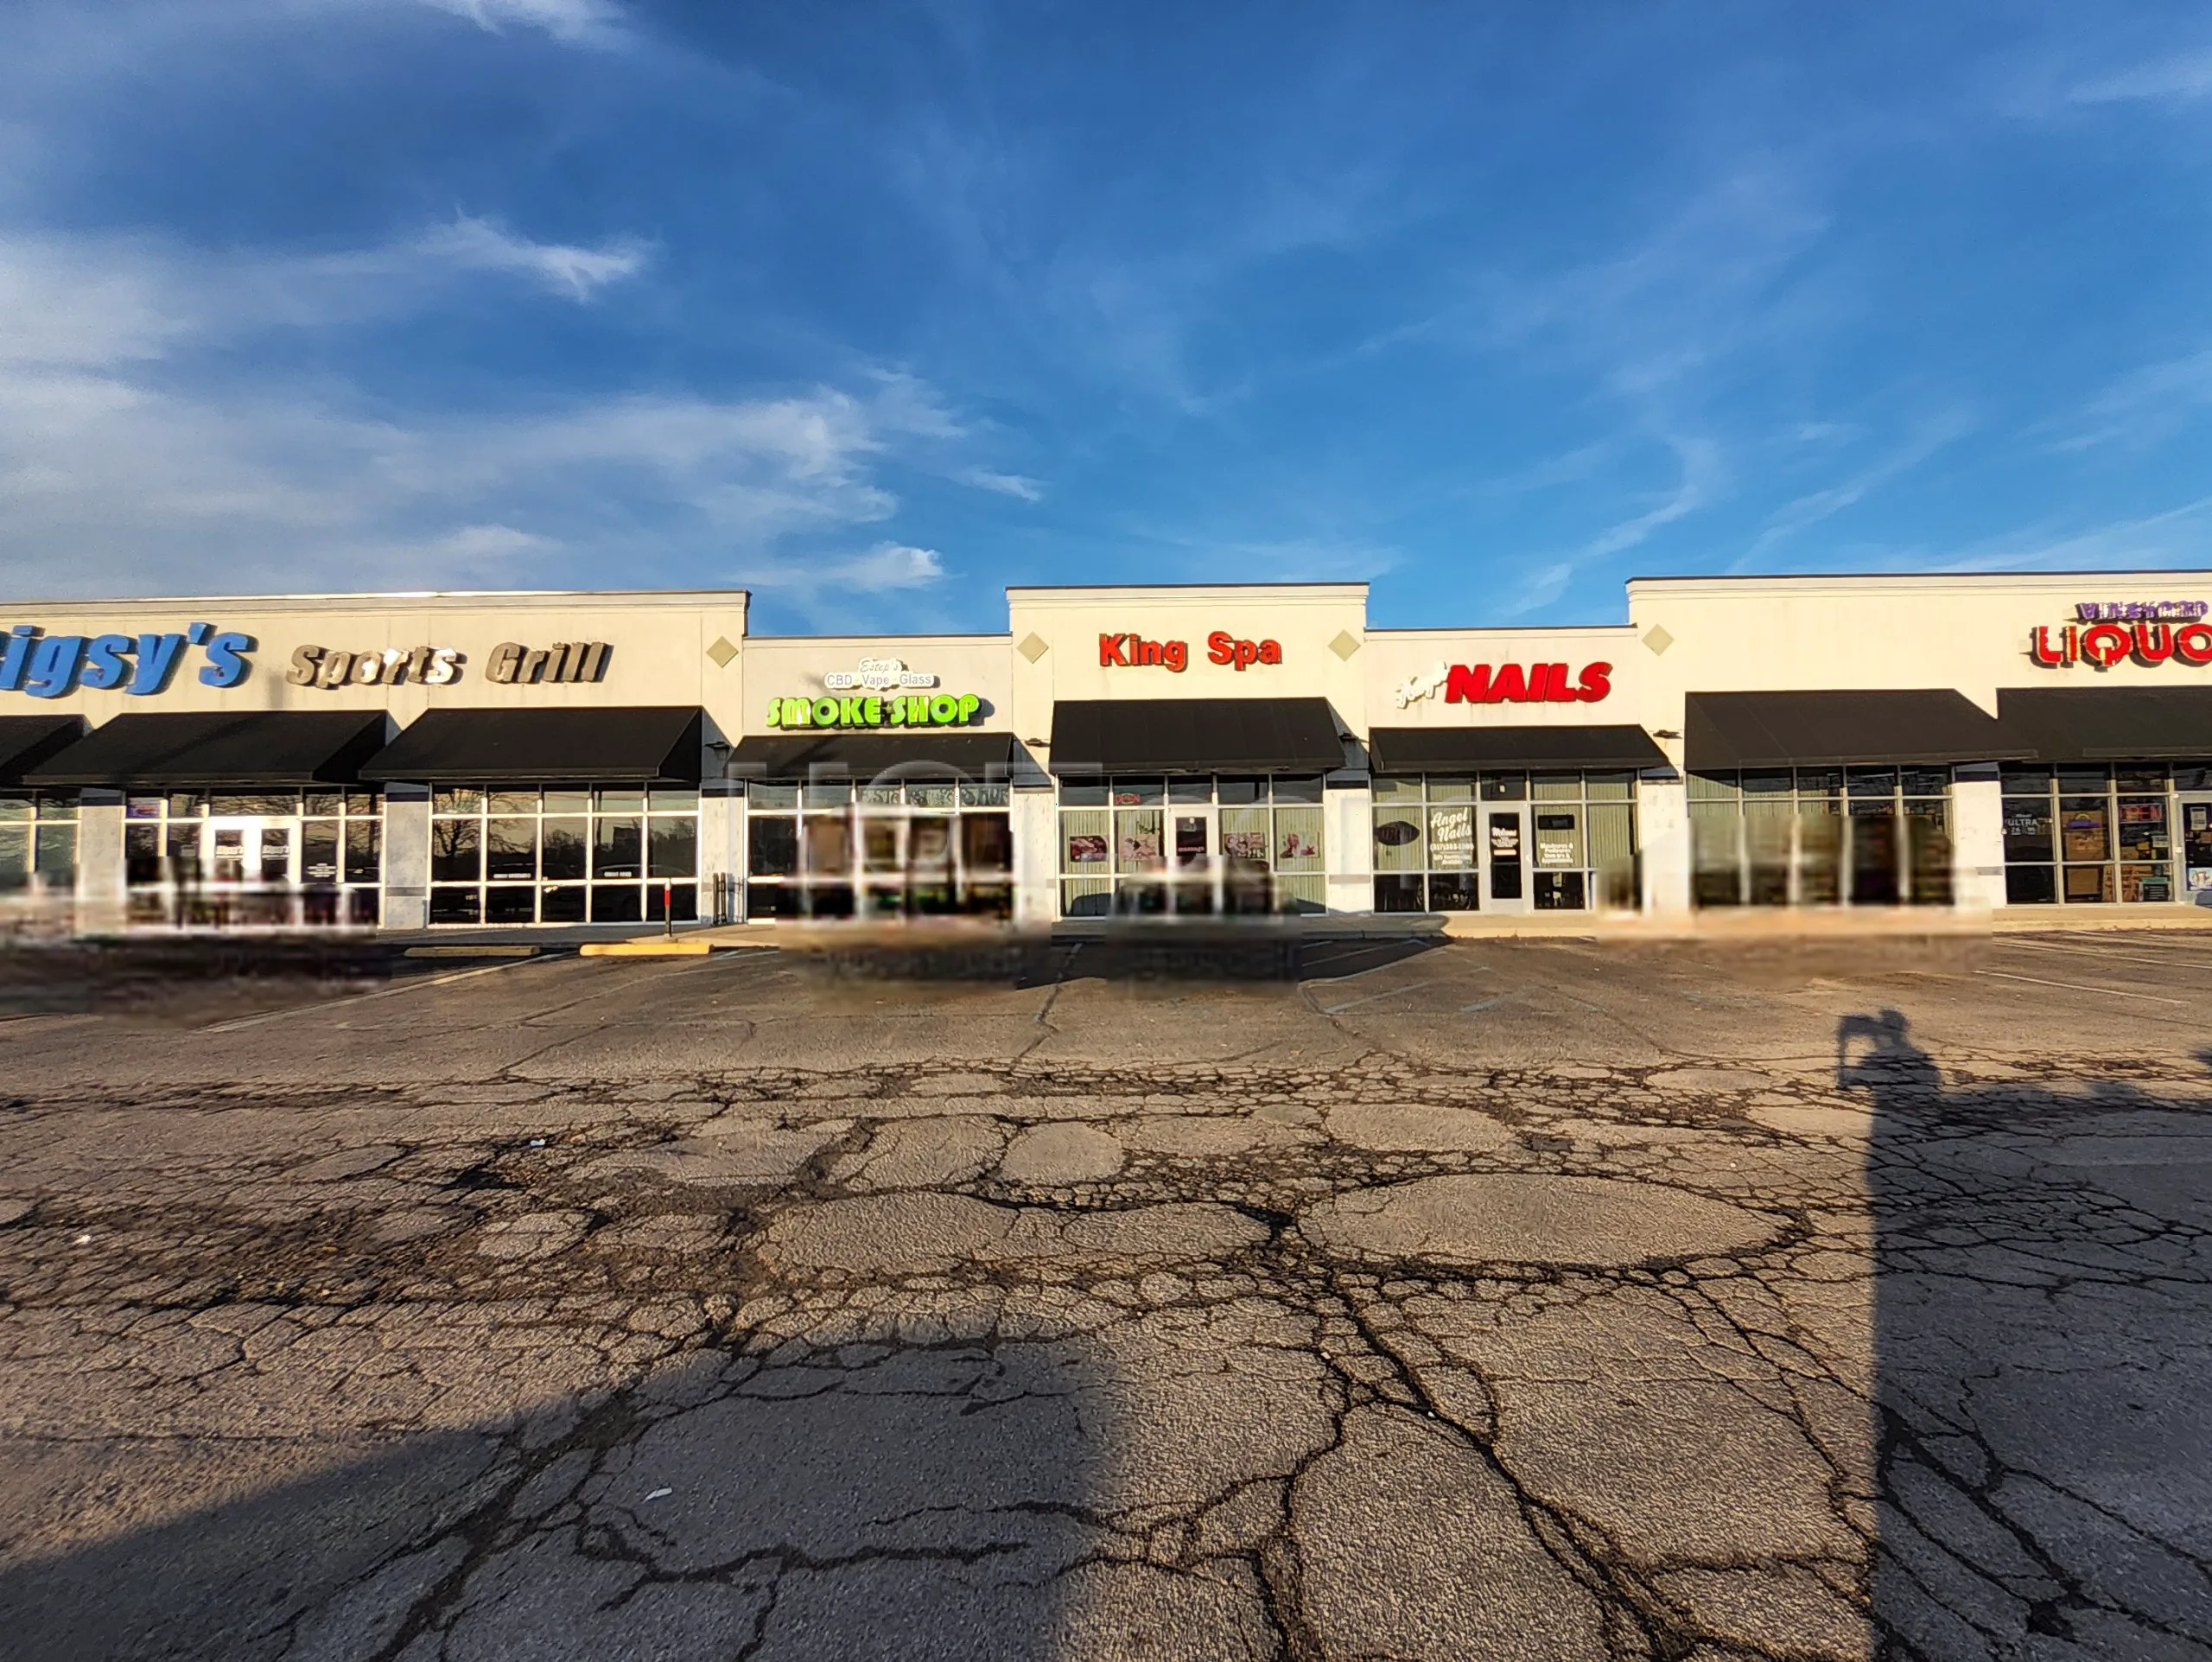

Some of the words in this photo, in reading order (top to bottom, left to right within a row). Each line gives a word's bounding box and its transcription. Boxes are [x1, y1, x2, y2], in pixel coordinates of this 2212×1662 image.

[0, 622, 251, 697] igsy's
[286, 645, 461, 688] Sports
[486, 641, 610, 684] Grill
[1099, 633, 1187, 672] King
[1207, 631, 1281, 671] Spa
[827, 674, 852, 685] CBD
[861, 674, 889, 687] Vape
[899, 674, 931, 685] Glass
[1445, 662, 1613, 703] NAILS
[766, 696, 881, 726] SMOKE
[890, 694, 980, 724] SHOP
[1431, 807, 1469, 830] Angel
[1438, 823, 1472, 842] Nails
